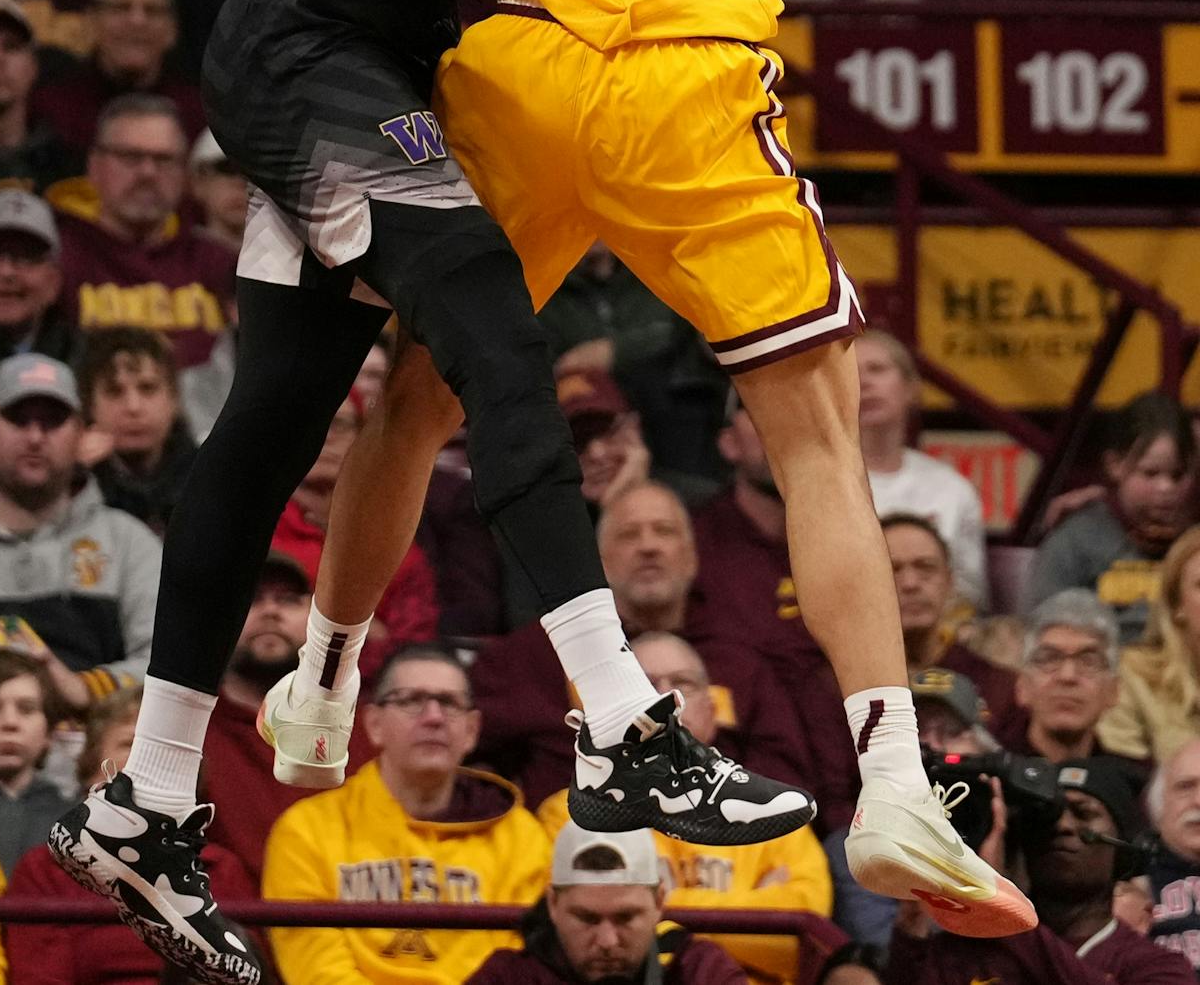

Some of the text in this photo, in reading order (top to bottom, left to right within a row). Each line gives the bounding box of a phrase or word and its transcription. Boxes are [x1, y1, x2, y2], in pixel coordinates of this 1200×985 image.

[835, 47, 956, 133] 101
[1016, 50, 1150, 135] 102
[379, 111, 447, 165] W
[941, 278, 1122, 327] HEAL
